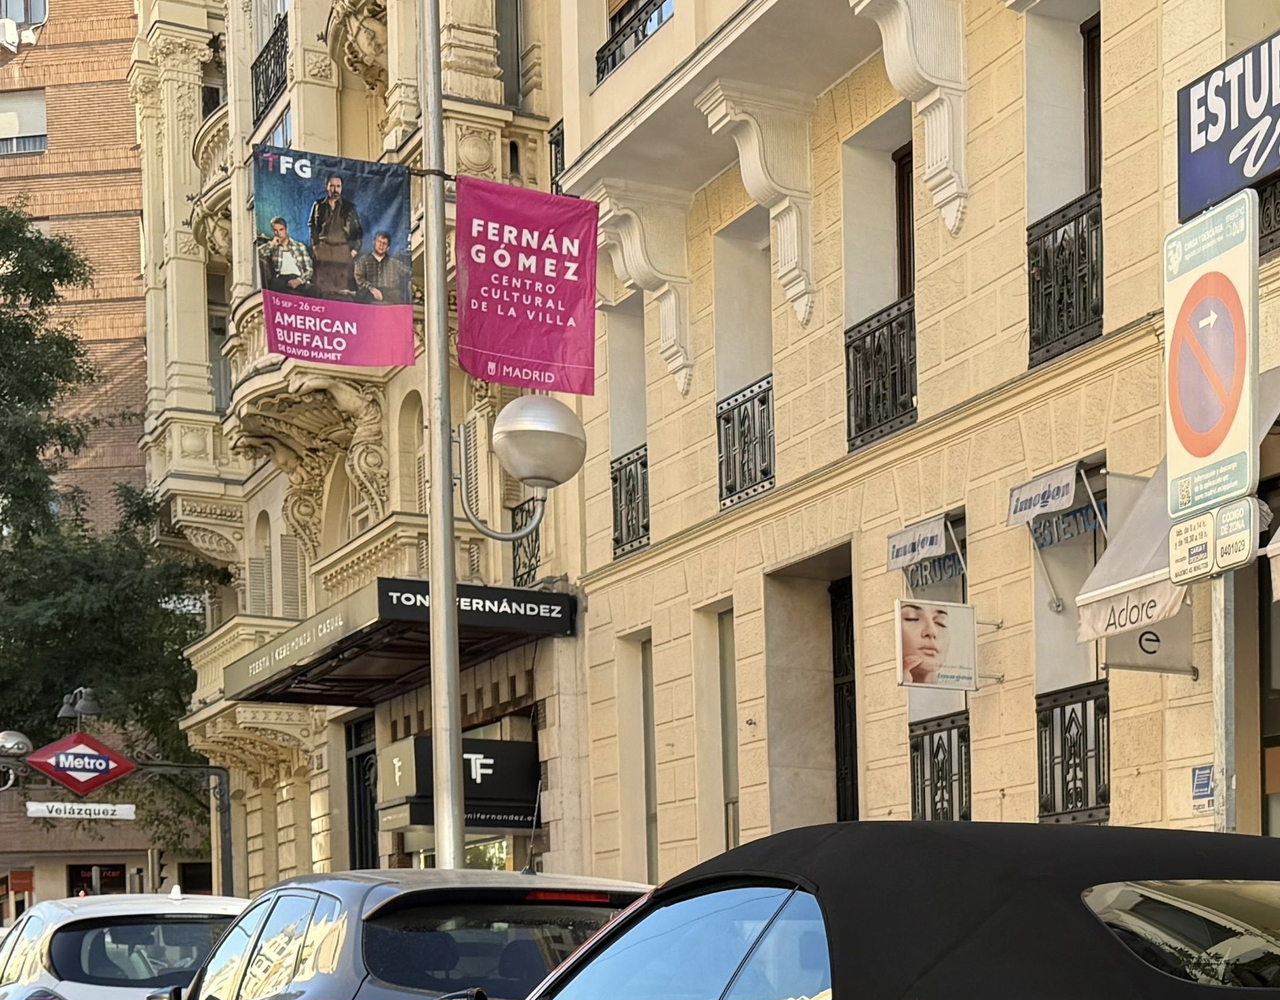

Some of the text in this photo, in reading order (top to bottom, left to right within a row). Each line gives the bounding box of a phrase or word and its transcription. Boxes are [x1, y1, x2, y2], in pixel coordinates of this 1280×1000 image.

[262, 152, 312, 179] TFG
[471, 218, 580, 257] FERNÁN
[470, 243, 579, 282] GÓMEZ
[491, 273, 556, 295] CENTRO
[272, 296, 280, 306] 16
[281, 300, 292, 308] SEP
[299, 301, 310, 311] 26
[311, 305, 325, 313] OCT
[480, 286, 565, 311] CULTURAL
[274, 311, 358, 335] AMERICAN
[471, 299, 576, 327] DE LA VILLA
[276, 328, 347, 351] BUFFALO
[287, 345, 310, 357] DAVID
[311, 350, 342, 361] MAMET
[503, 365, 555, 383] MADRID
[1220, 539, 1245, 558] 0401029
[388, 592, 430, 607] TON
[1104, 595, 1157, 632] Adore
[249, 655, 269, 677] FIESTA
[317, 613, 344, 637] CASUAL
[59, 753, 107, 771] Metro
[463, 753, 495, 784] TF
[46, 804, 118, 818] Velázquez
